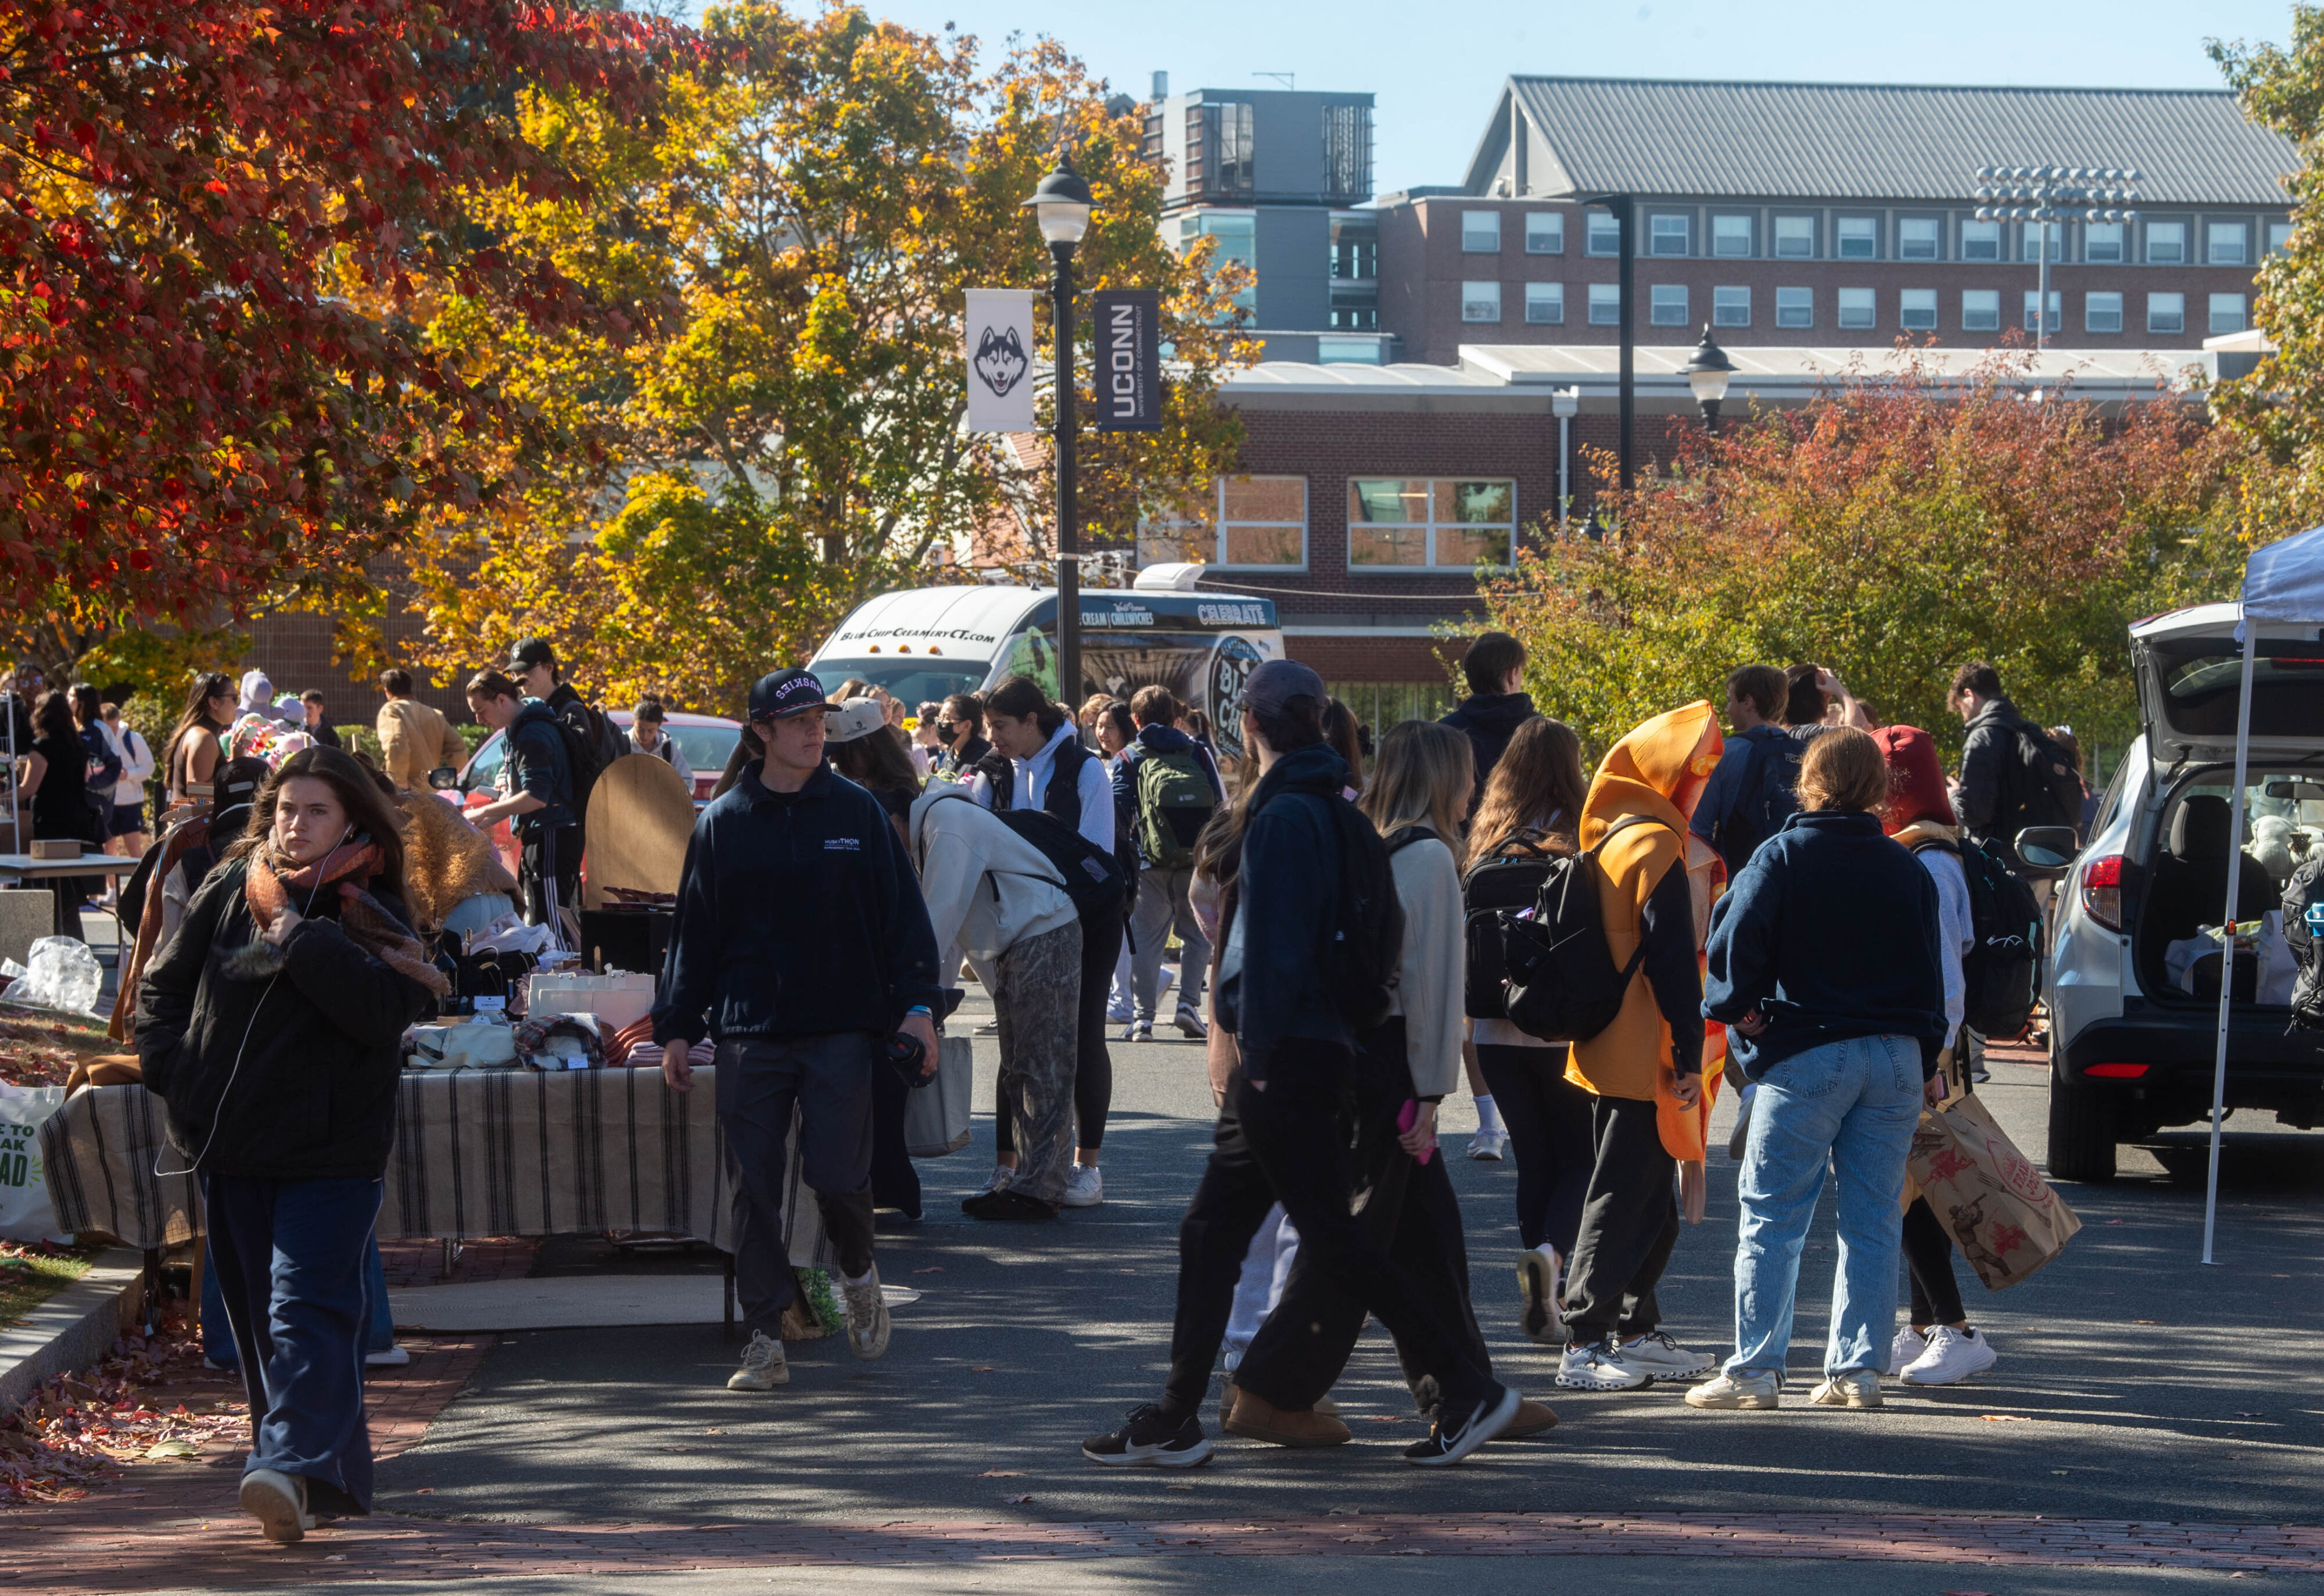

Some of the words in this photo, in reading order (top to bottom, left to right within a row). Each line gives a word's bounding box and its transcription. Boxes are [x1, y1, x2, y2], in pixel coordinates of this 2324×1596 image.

[1111, 305, 1135, 417] UCONN
[1136, 360, 1143, 371] OF
[1082, 612, 1107, 626] CREAM
[1197, 604, 1265, 625] CELEBRATE
[776, 677, 823, 700] HUSKIES
[10, 1124, 35, 1138] TO
